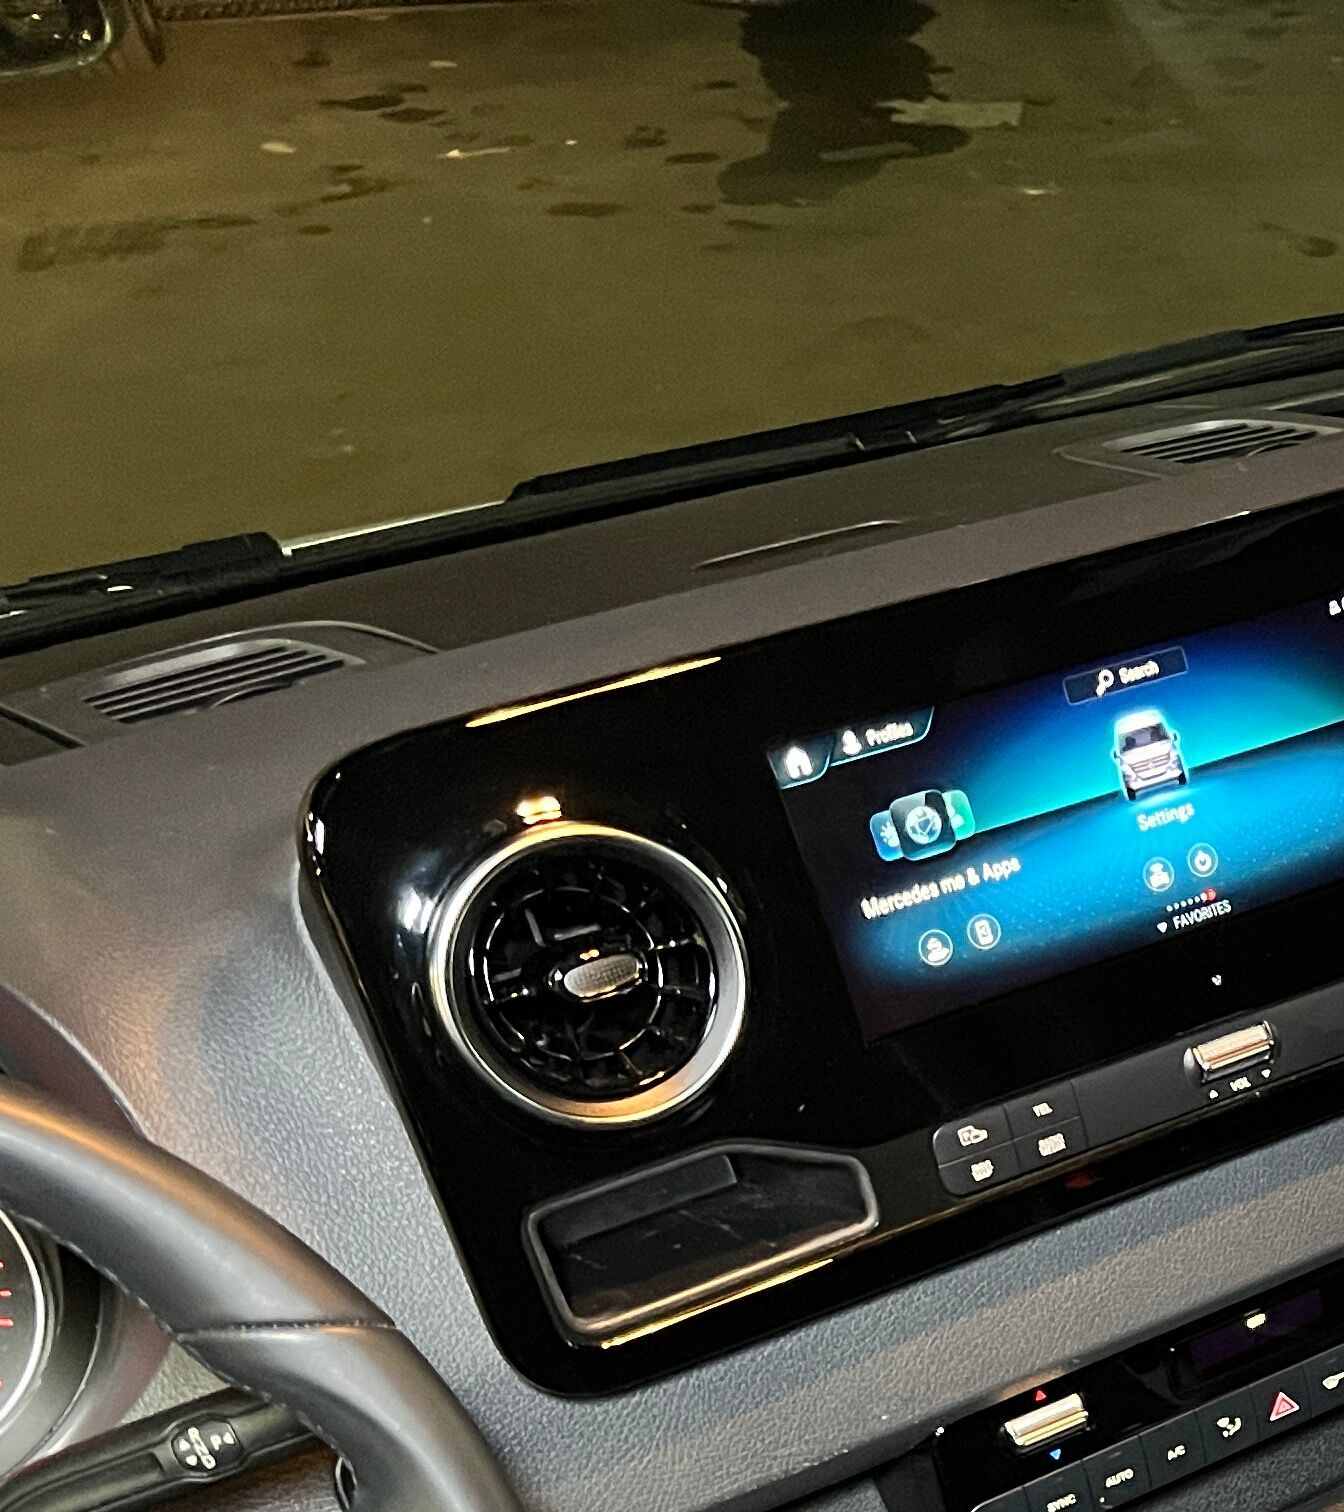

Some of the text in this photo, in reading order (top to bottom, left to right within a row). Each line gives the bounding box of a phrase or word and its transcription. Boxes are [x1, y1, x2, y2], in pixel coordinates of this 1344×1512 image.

[1118, 660, 1160, 685] Search
[865, 722, 914, 746] Profiles
[1137, 802, 1196, 831] Settings
[860, 857, 1021, 919] Mercedes me & Apps
[1172, 899, 1232, 930] FAVORITES
[1105, 1468, 1135, 1488] AUTO
